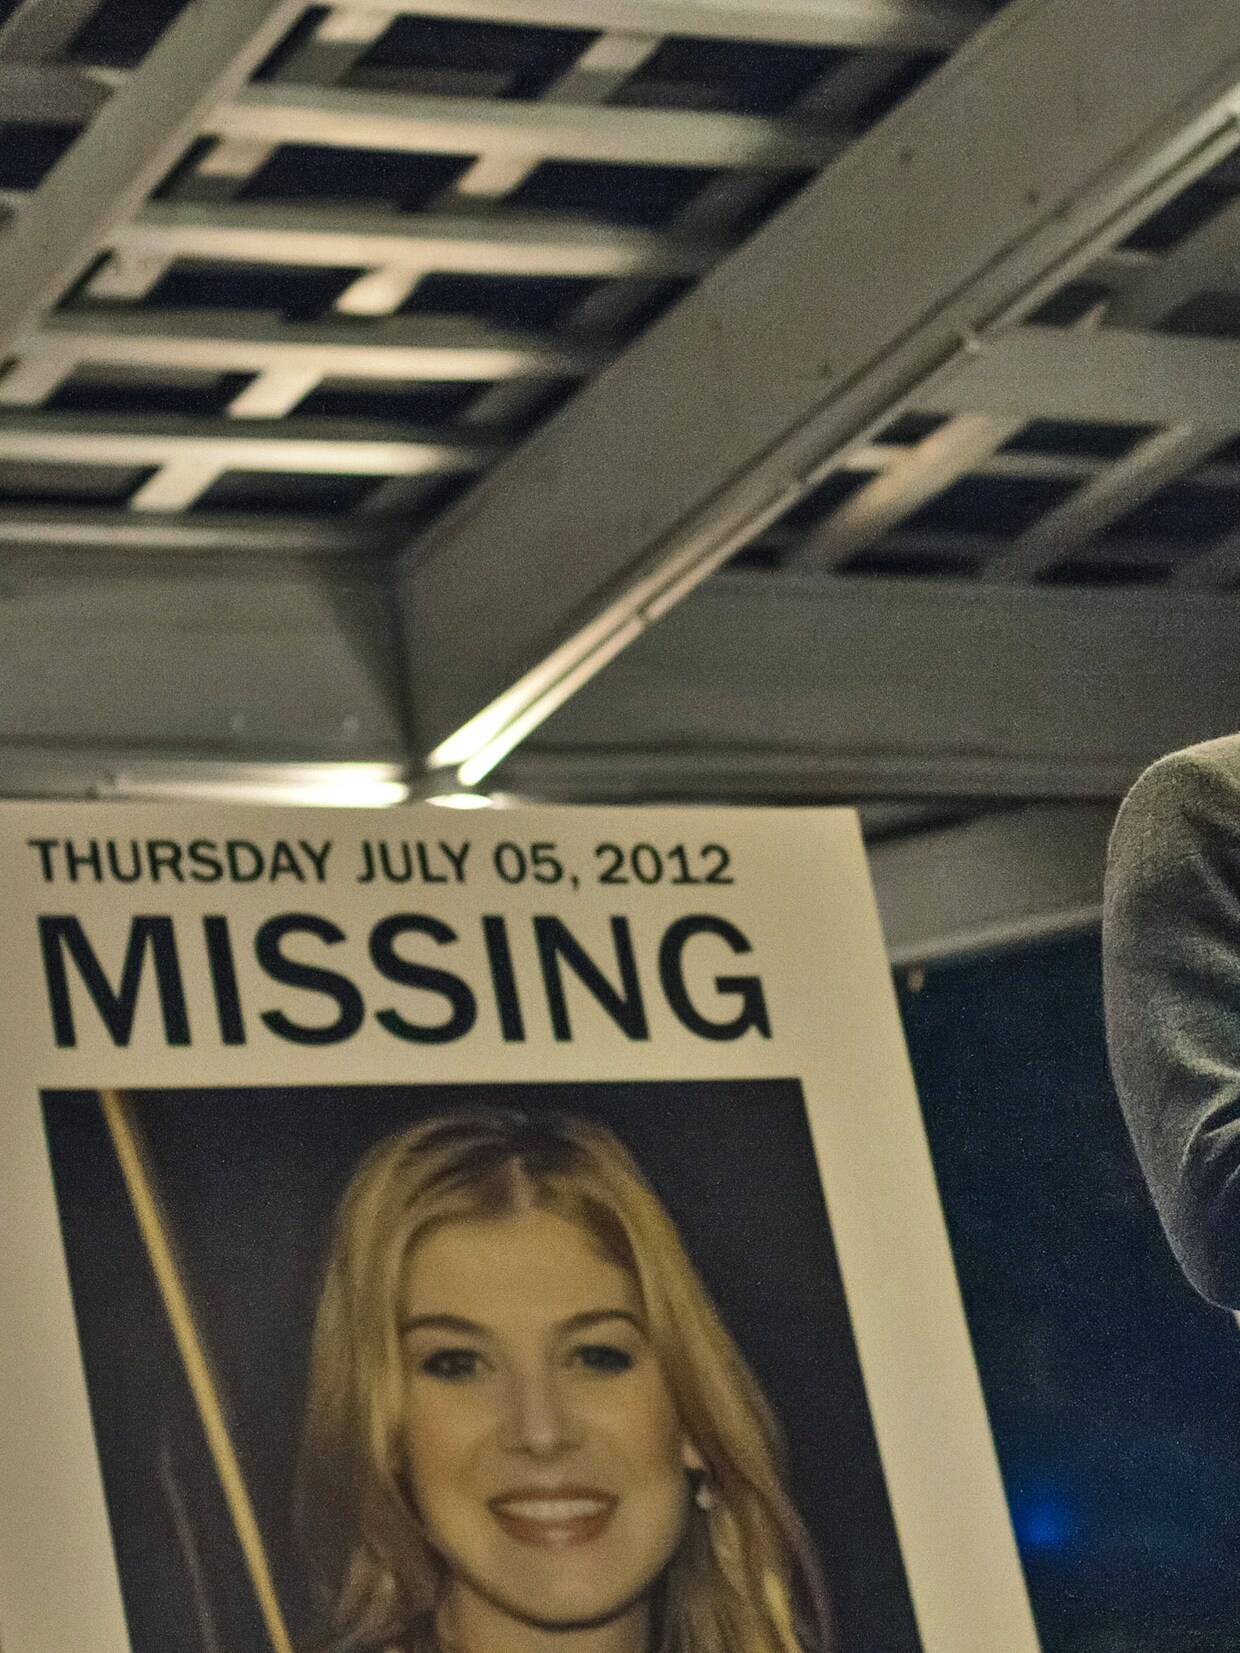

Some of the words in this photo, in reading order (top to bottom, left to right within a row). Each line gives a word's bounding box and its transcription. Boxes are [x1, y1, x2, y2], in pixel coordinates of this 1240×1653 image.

[28, 838, 333, 884] THURSDAY
[356, 841, 471, 885] JULY
[494, 843, 581, 891] 05,
[595, 843, 735, 886] 2012
[37, 912, 773, 1048] MISSING
